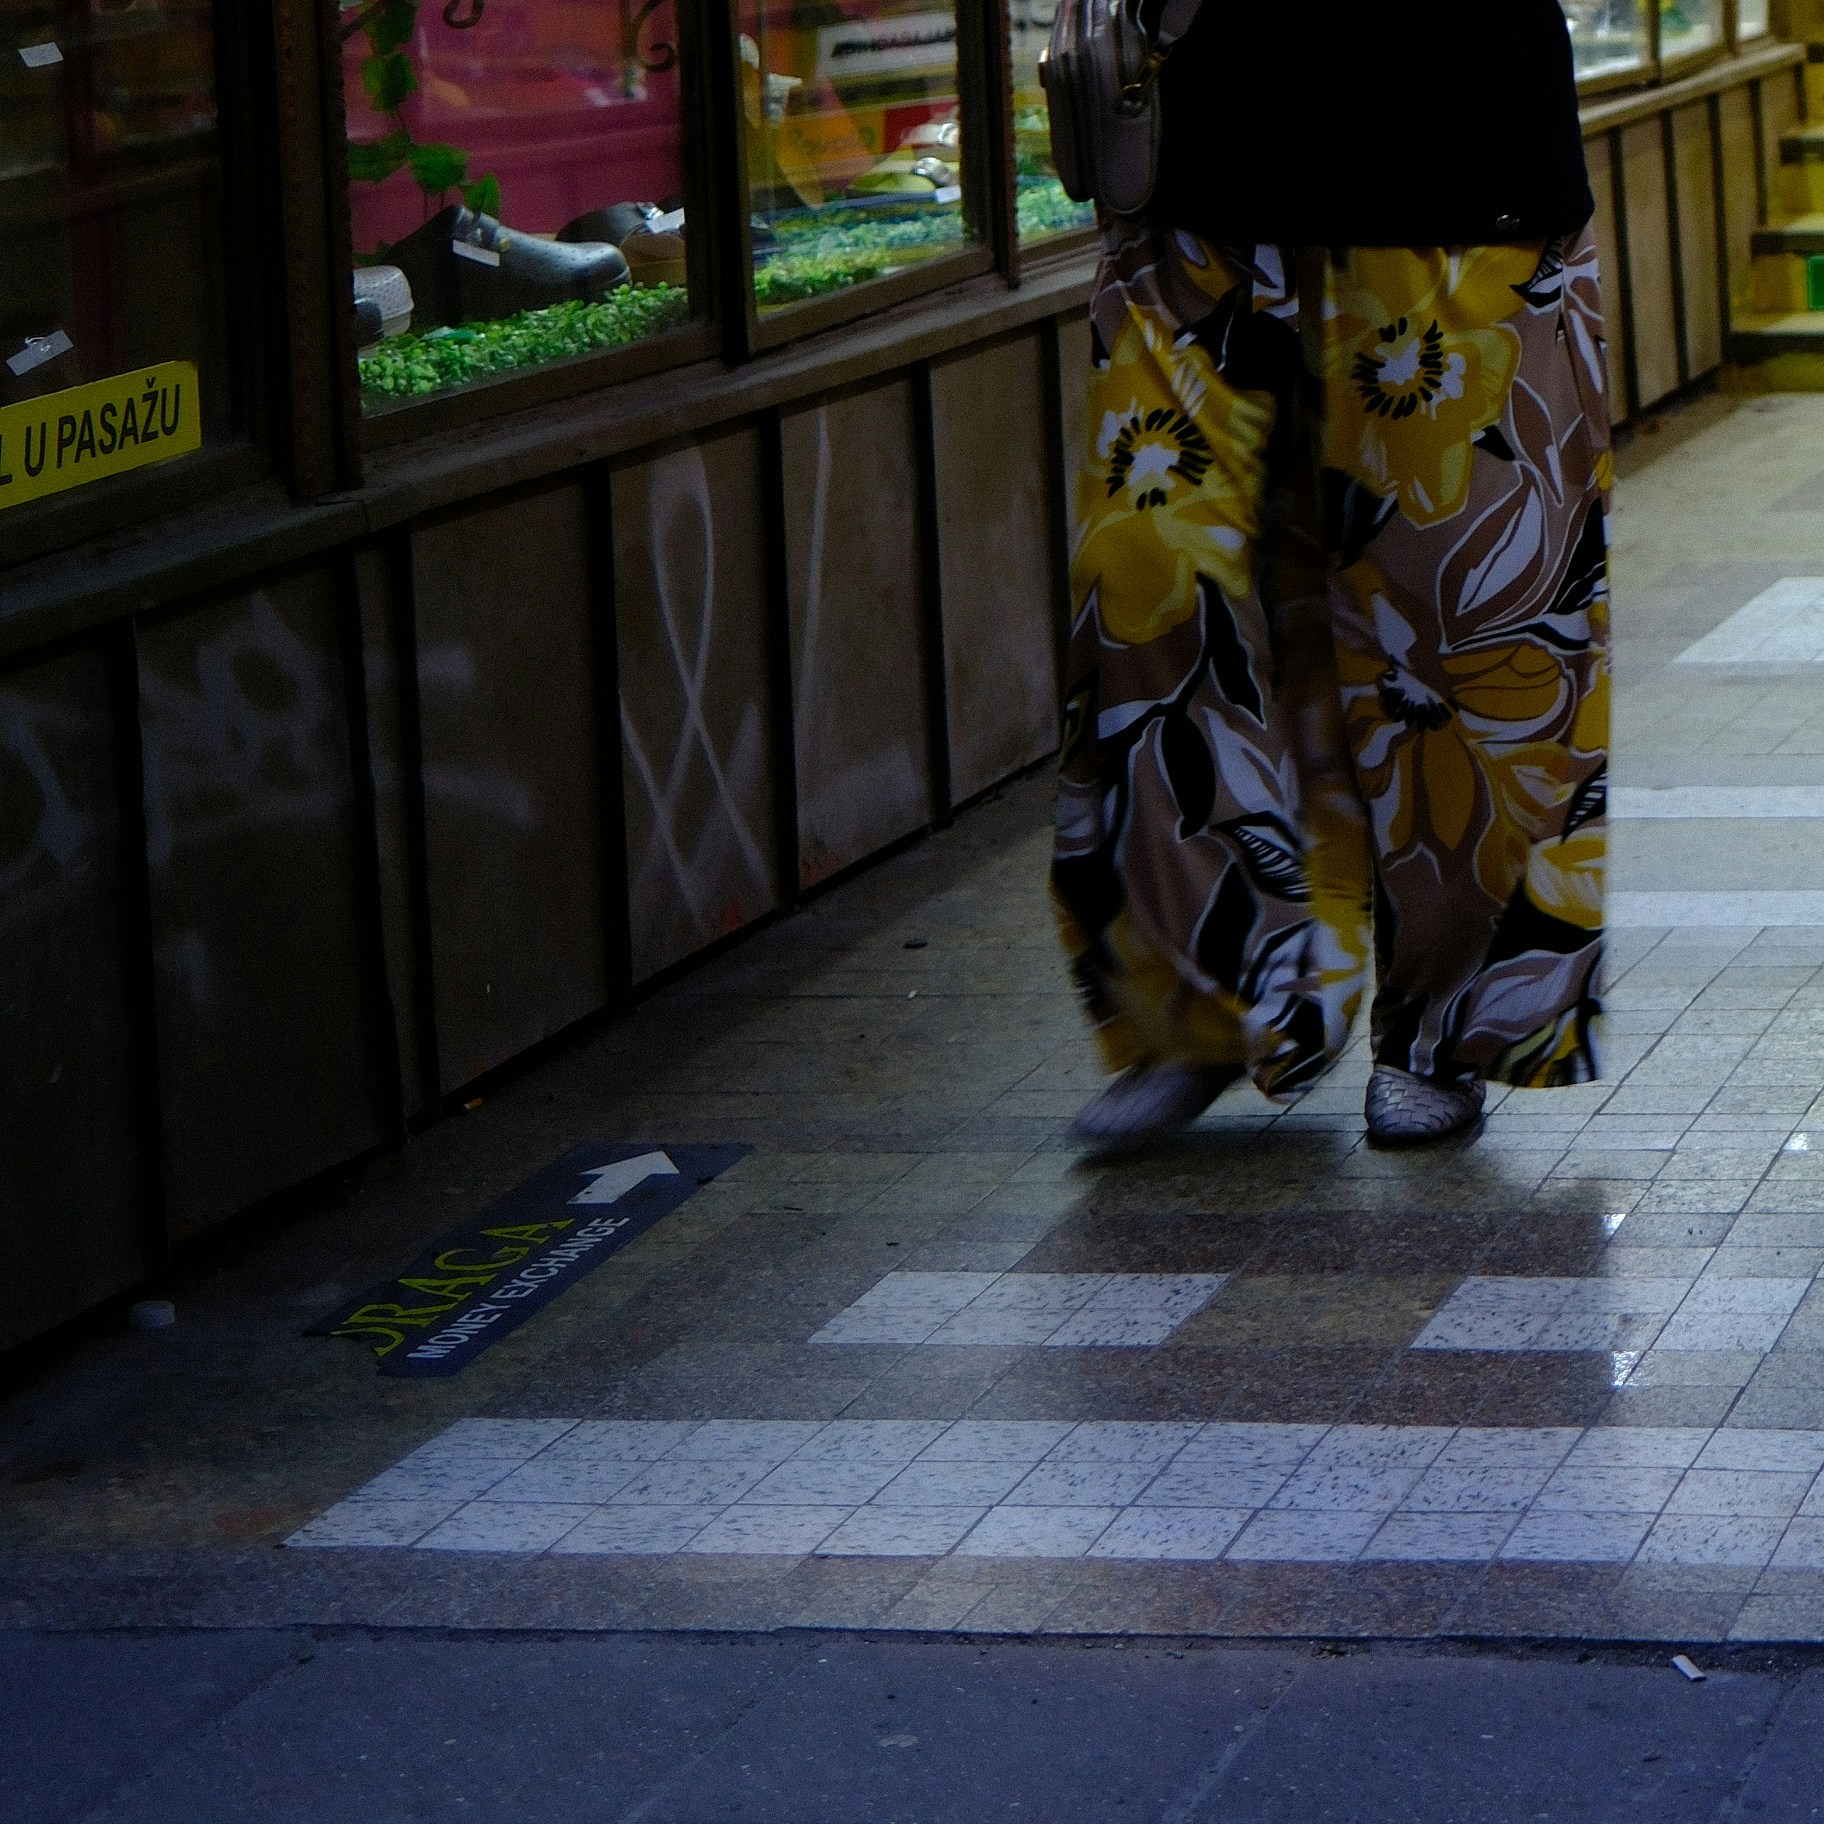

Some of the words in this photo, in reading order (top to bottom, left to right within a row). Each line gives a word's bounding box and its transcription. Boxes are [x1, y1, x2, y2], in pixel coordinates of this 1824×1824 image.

[25, 421, 47, 477] U
[57, 376, 181, 469] PASAŽU
[407, 1303, 512, 1360] MONEY
[490, 1216, 631, 1300] EXCHANGE
